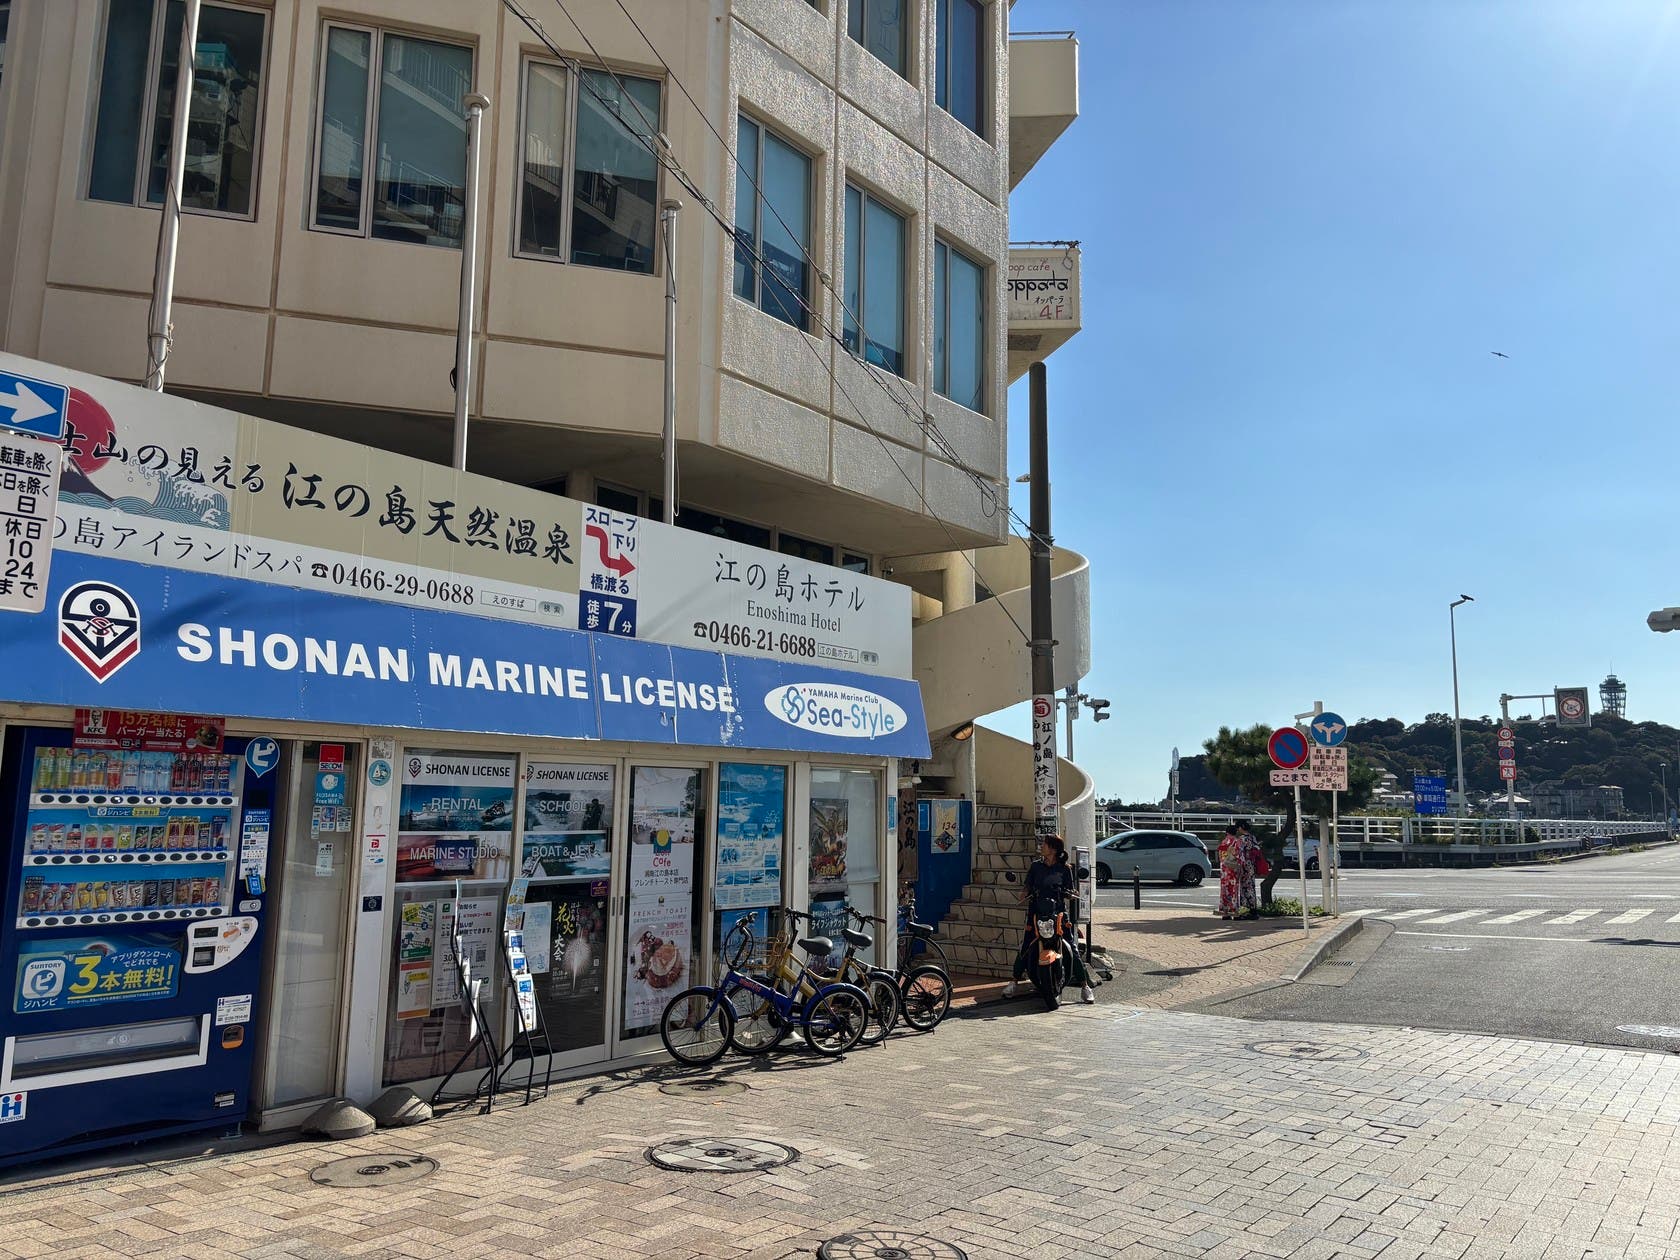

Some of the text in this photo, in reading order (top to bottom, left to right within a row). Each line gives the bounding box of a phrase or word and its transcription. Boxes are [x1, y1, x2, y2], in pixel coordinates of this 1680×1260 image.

[1034, 295, 1065, 304] オッパーラ
[0, 472, 50, 498] 日を除く
[60, 420, 574, 565] 士山の見える 江の島天然温泉
[5, 517, 42, 540] 休日
[586, 507, 638, 533] スロープ
[9, 538, 33, 559] 10
[612, 532, 637, 552] 下り
[5, 559, 34, 580] 24
[0, 578, 39, 598] まで
[332, 561, 474, 606] 0466-29-0688
[590, 573, 630, 595] 橋渡る
[715, 552, 866, 613] 江の島ホテル
[586, 599, 633, 634] 徒歩 7 分
[746, 600, 842, 633] Enoshima Hotel
[708, 620, 817, 658] 0466-21-6688
[177, 622, 736, 714] SHONAN MARINE LICENSE
[808, 687, 880, 704] YAMAHA Marine Club
[86, 726, 105, 735] KFC
[807, 701, 895, 741] Sea-Style
[320, 762, 342, 770] SECOM
[425, 764, 511, 777] SHONAN LICENSE
[536, 770, 609, 781] SHONAN LICENSE
[1272, 773, 1309, 783] ここまで
[431, 797, 485, 811] RENTAL
[539, 800, 588, 812] SCHOOL
[410, 846, 499, 861] MARINE STUDIO
[30, 962, 63, 970] SUNTORY
